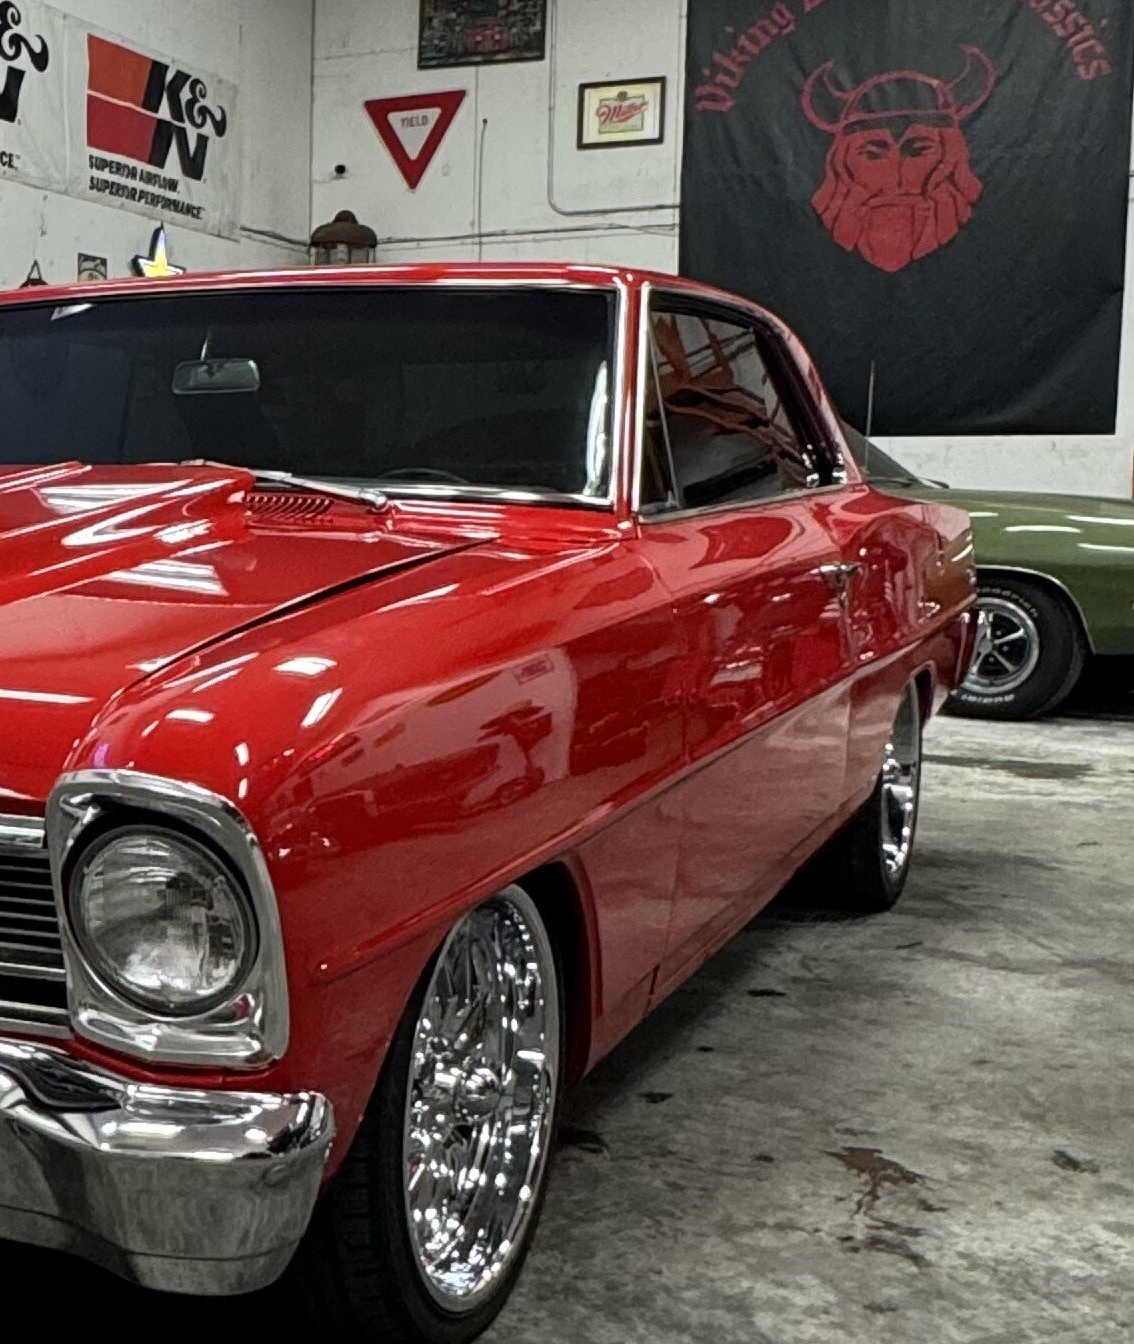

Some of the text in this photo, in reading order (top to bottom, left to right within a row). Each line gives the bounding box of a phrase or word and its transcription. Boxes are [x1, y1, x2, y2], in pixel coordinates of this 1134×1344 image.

[695, 0, 796, 112] Viking
[400, 114, 429, 129] YIELD
[596, 101, 648, 124] Miller
